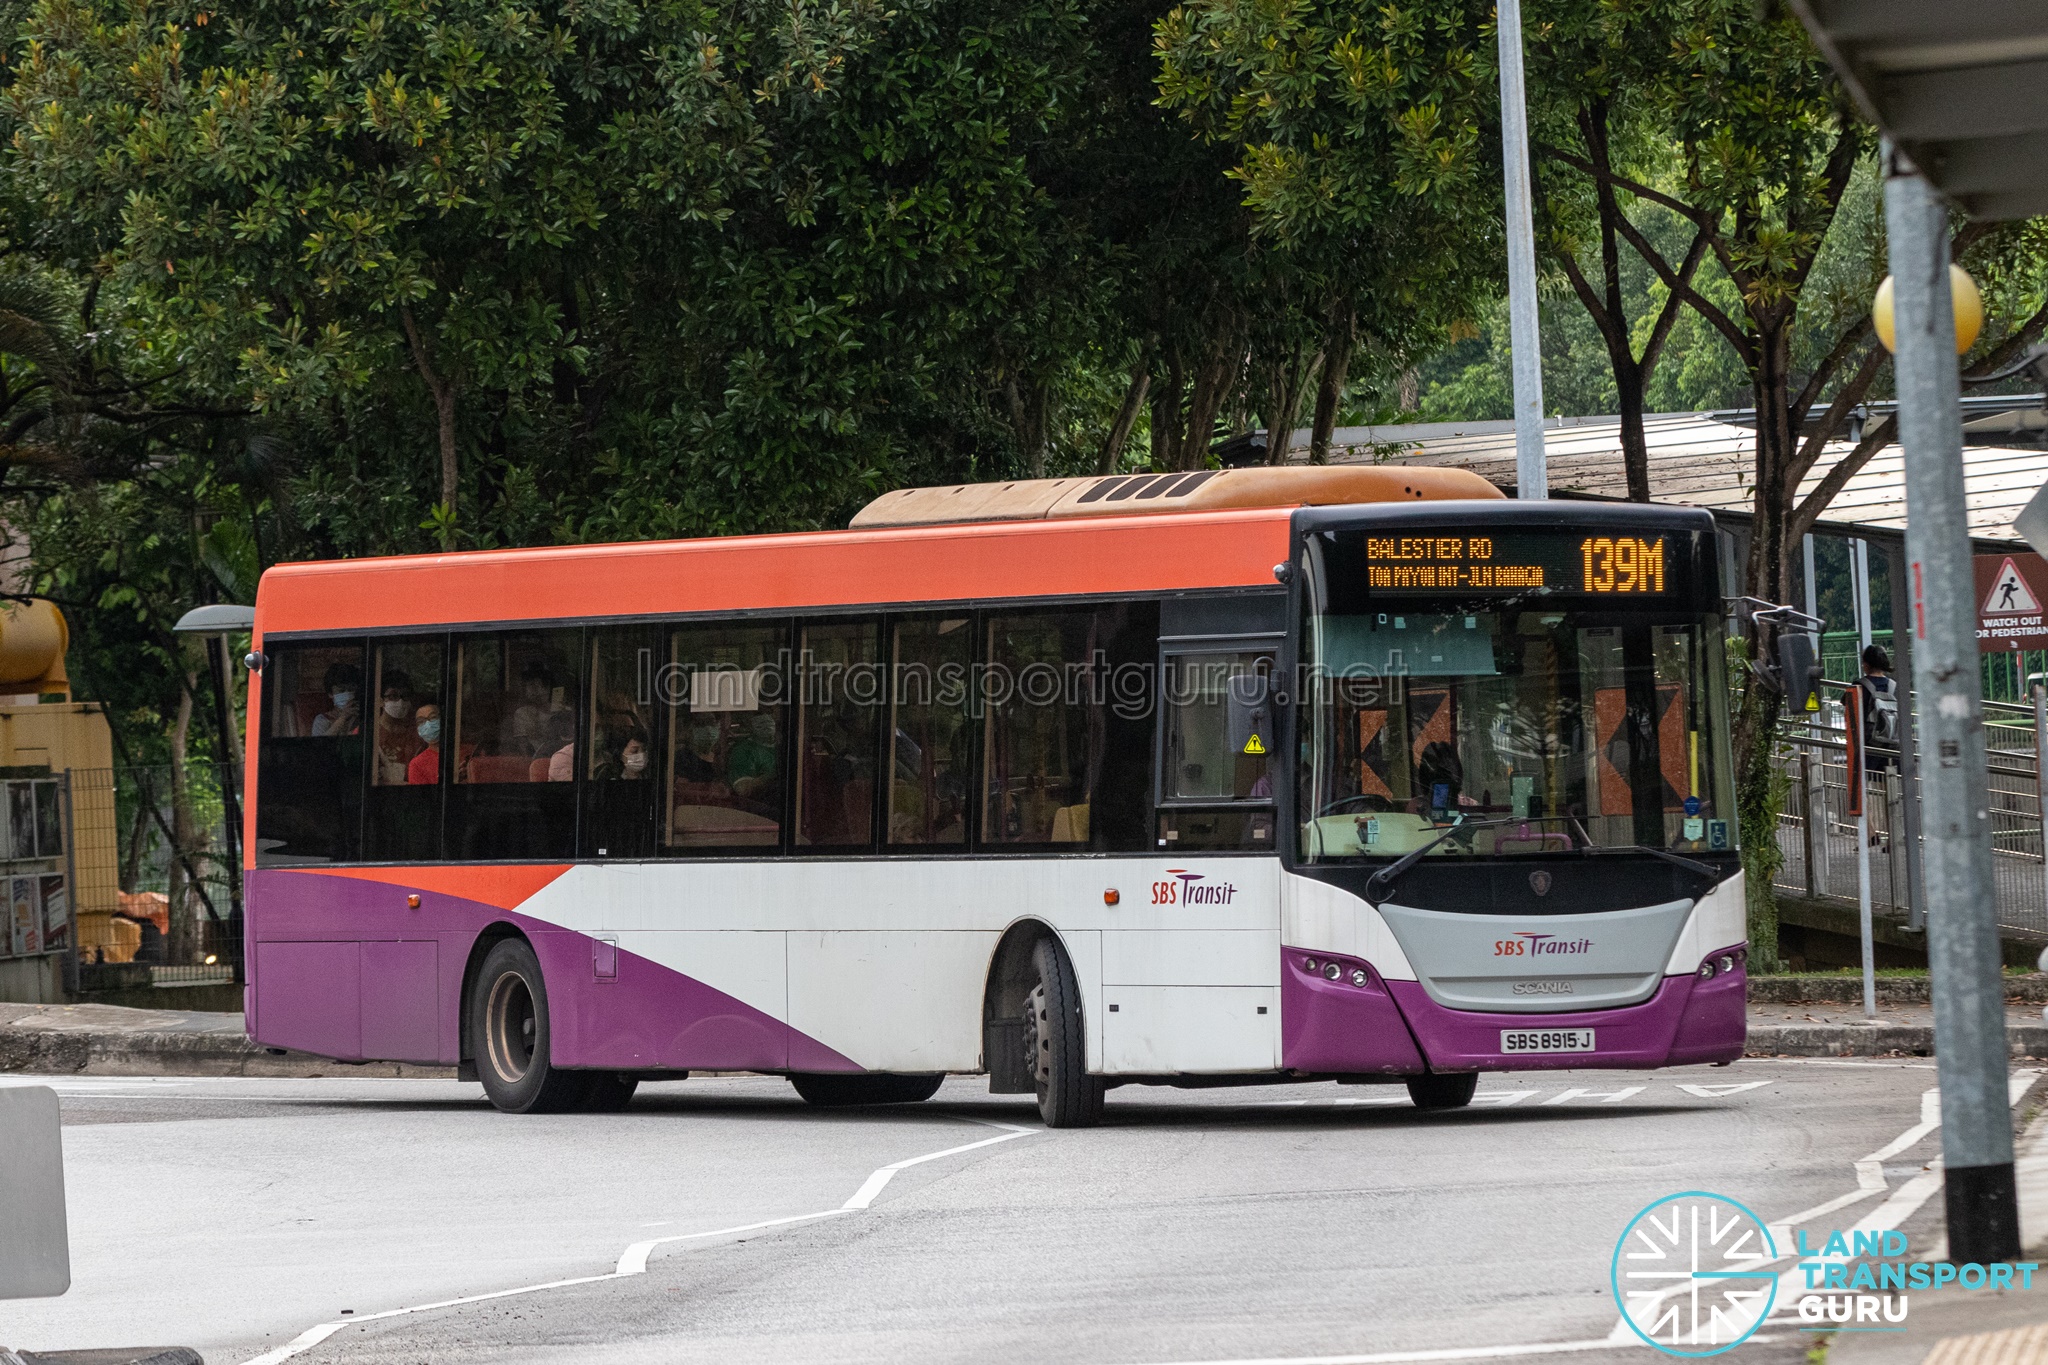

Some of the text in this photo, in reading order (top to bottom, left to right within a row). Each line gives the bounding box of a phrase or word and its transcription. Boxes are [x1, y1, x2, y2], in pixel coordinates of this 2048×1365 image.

[1367, 538, 1492, 559] BALESTIER RD
[1580, 537, 1664, 592] 139M
[1368, 566, 1391, 587] TOA
[1393, 566, 1436, 587] PAYOH
[1975, 626, 2048, 638] OR PEDESTRIAN
[1983, 616, 2042, 627] WATCH OUT
[1152, 874, 1239, 908] SBS Transit
[1494, 934, 1595, 958] SBS Transit
[1513, 982, 1573, 994] SCANIA
[1506, 1032, 1591, 1051] SBS8915J
